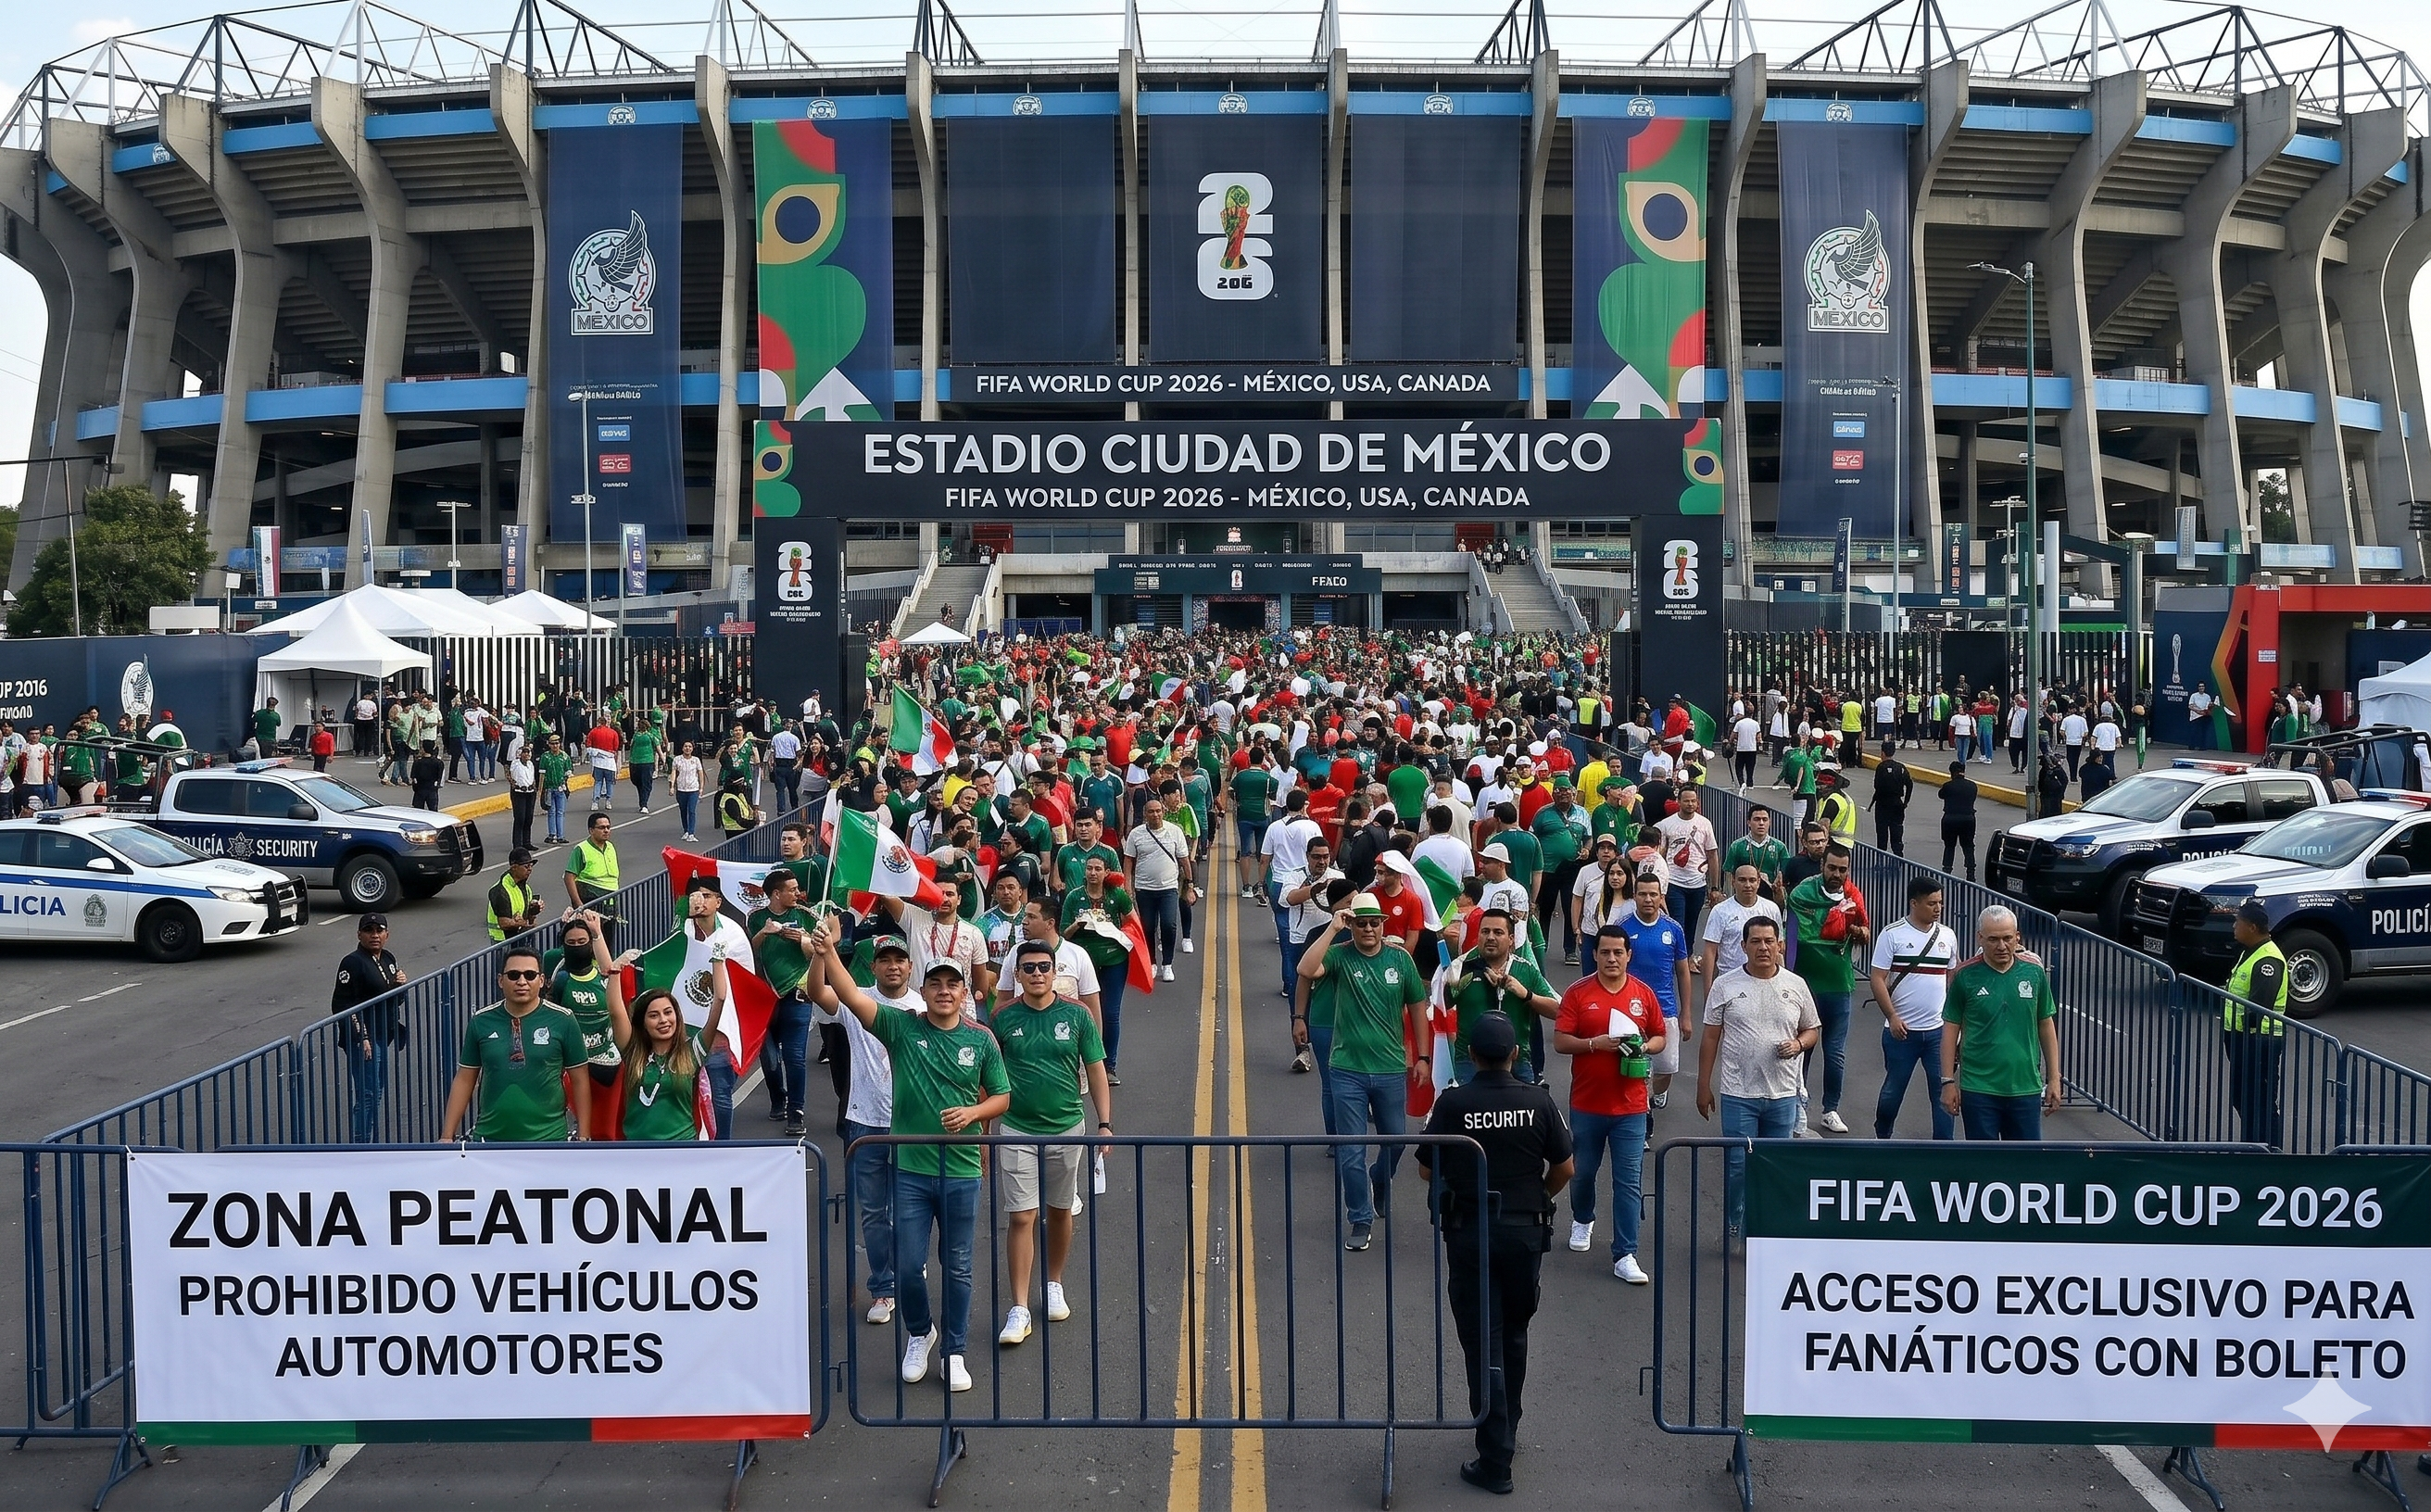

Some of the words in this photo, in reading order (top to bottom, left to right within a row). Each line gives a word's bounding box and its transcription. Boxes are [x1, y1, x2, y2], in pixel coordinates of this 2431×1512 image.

[576, 310, 648, 330] MÉXICO
[1813, 308, 1884, 327] MÉXICO
[976, 375, 1023, 393] FIFA
[1027, 375, 1111, 393] WORLD
[1117, 375, 1164, 393] CUP
[1168, 374, 1224, 393] 2026
[1243, 369, 1336, 395] MÉXICO,
[1341, 374, 1392, 395] USA,
[1397, 374, 1492, 393] CANADA
[864, 434, 1087, 473] ESTADIO
[1102, 434, 1303, 473] CIUDAD
[1319, 433, 1386, 472] DE
[1404, 421, 1611, 472] MÉXICO
[946, 487, 999, 508] FIFA
[1004, 487, 1098, 508] WORLD
[1104, 487, 1156, 508] CUP
[1163, 487, 1224, 508] 2026
[1248, 483, 1353, 510] MÉXICO,
[1360, 486, 1417, 510] USA,
[1423, 486, 1530, 507] CANADA
[15, 679, 48, 698] 2016
[256, 839, 319, 858] SECURITY
[2372, 902, 2431, 935] POLICÍ
[1464, 1109, 1535, 1129] SECURITY
[168, 1191, 368, 1249] ZONA
[389, 1187, 768, 1246] PEATONAL
[1809, 1178, 1917, 1222] FIFA
[1931, 1181, 2117, 1225] WORLD
[2134, 1184, 2240, 1226] CUP
[2257, 1187, 2383, 1228] 2026
[179, 1273, 456, 1317] PROHIBIDO
[470, 1261, 759, 1313] VEHÍCULOS
[1780, 1272, 1979, 1315] ACCESO
[1996, 1276, 2267, 1319] EXCLUSIVO
[2284, 1279, 2415, 1320] PARA
[274, 1332, 663, 1378] AUTOMOTORES
[1806, 1324, 2080, 1376] FANÁTICOS
[2095, 1337, 2198, 1378] CON
[2215, 1338, 2406, 1380] BOLETO
